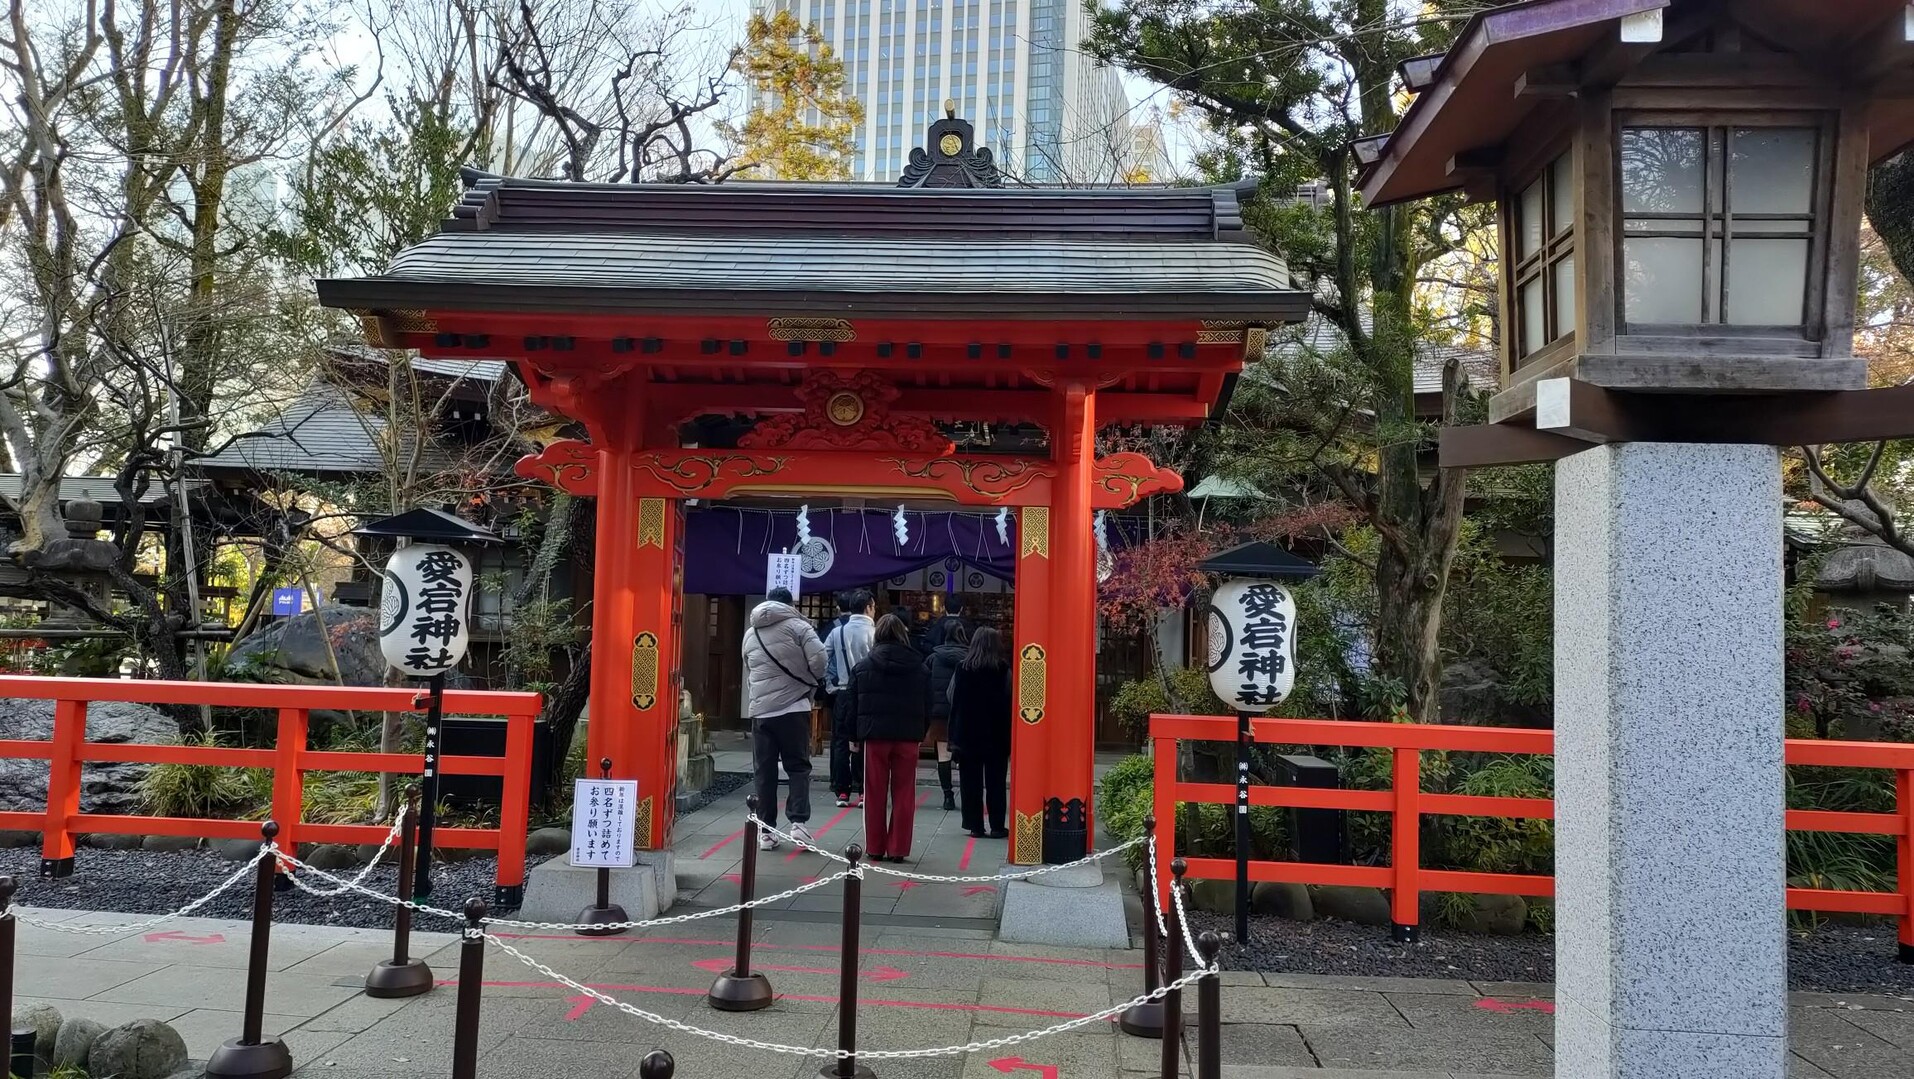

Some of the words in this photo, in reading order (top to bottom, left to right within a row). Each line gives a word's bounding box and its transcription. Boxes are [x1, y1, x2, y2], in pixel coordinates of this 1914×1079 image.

[404, 551, 463, 669] 愛宕神社
[1235, 583, 1287, 705] 愛宕神社
[586, 786, 600, 860] お参り願います
[601, 787, 614, 860] 四名ずつ詰めて
